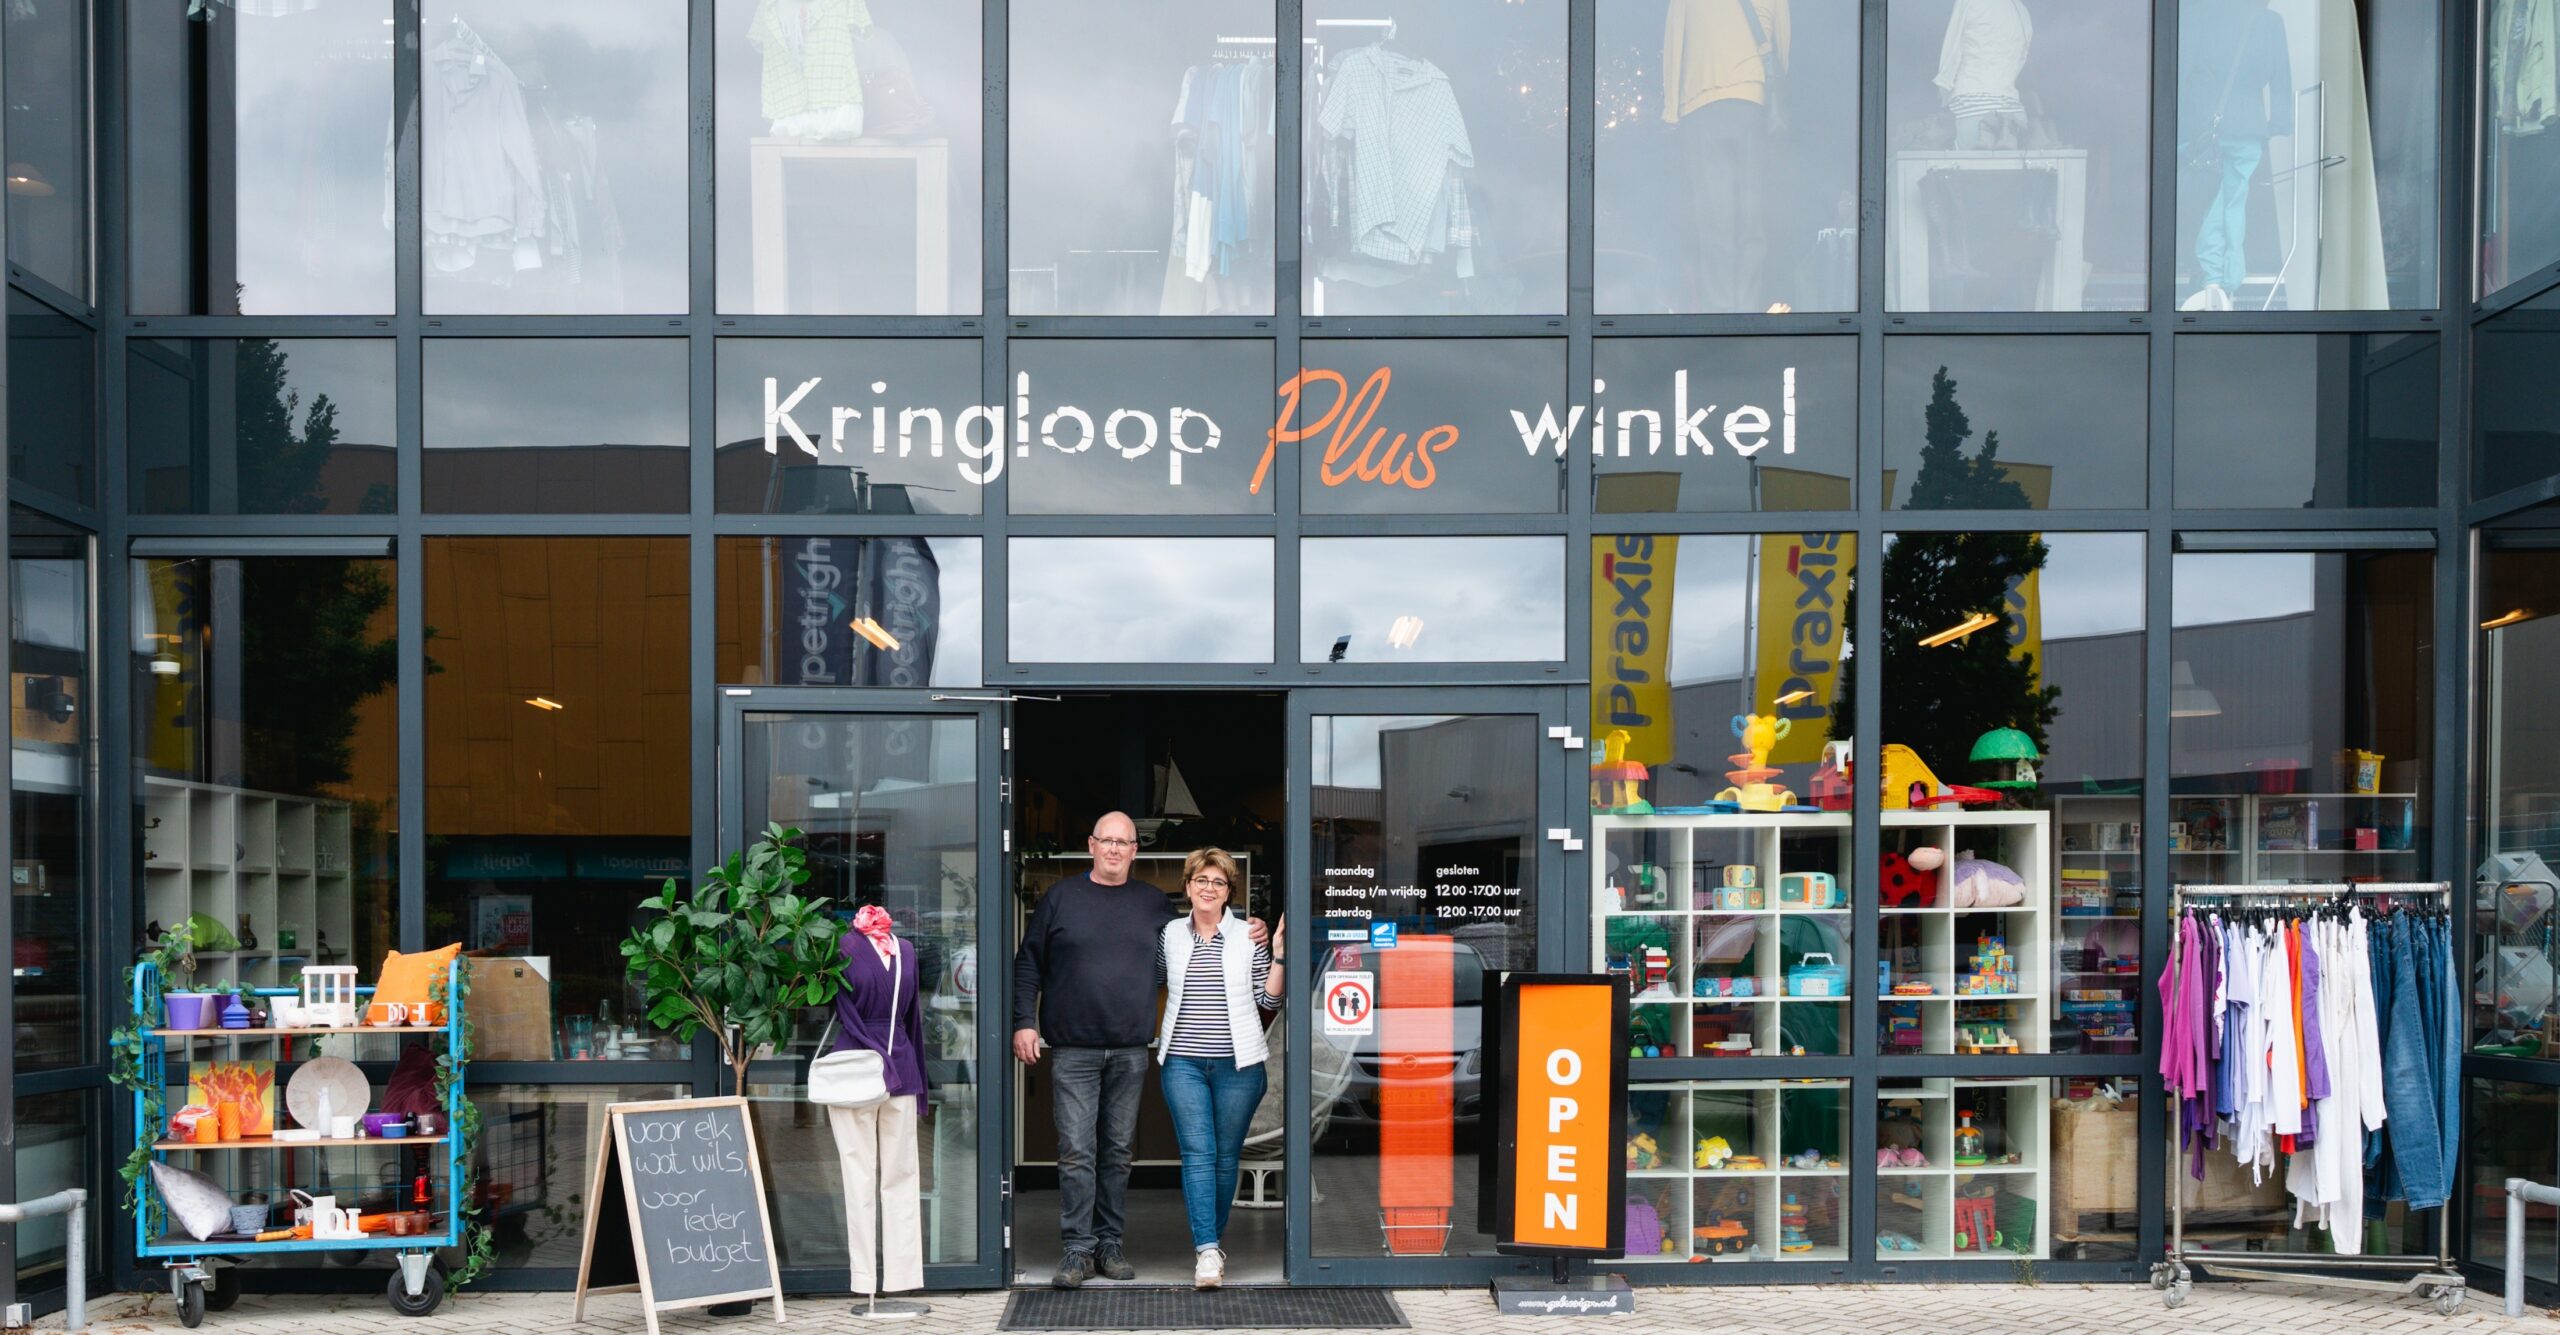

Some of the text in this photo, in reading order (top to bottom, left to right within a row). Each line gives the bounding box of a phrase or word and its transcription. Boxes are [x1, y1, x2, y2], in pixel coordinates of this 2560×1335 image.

[764, 366, 1796, 495] Kringloop Plus winkel
[1324, 864, 1480, 878] maandag gesloten
[1324, 885, 1366, 898] dinsdag
[1368, 885, 1388, 897] t/m
[1390, 885, 1427, 898] vrijdag
[1503, 888, 1521, 896] uur
[1324, 906, 1372, 919] zaterdag
[1503, 908, 1521, 917] uur
[628, 1111, 732, 1144] voor elk
[1543, 1048, 1582, 1231] OPEN
[635, 1142, 748, 1177] wat wils,
[642, 1189, 706, 1209] voor
[684, 1203, 746, 1231] ieder
[667, 1229, 762, 1272] budget
